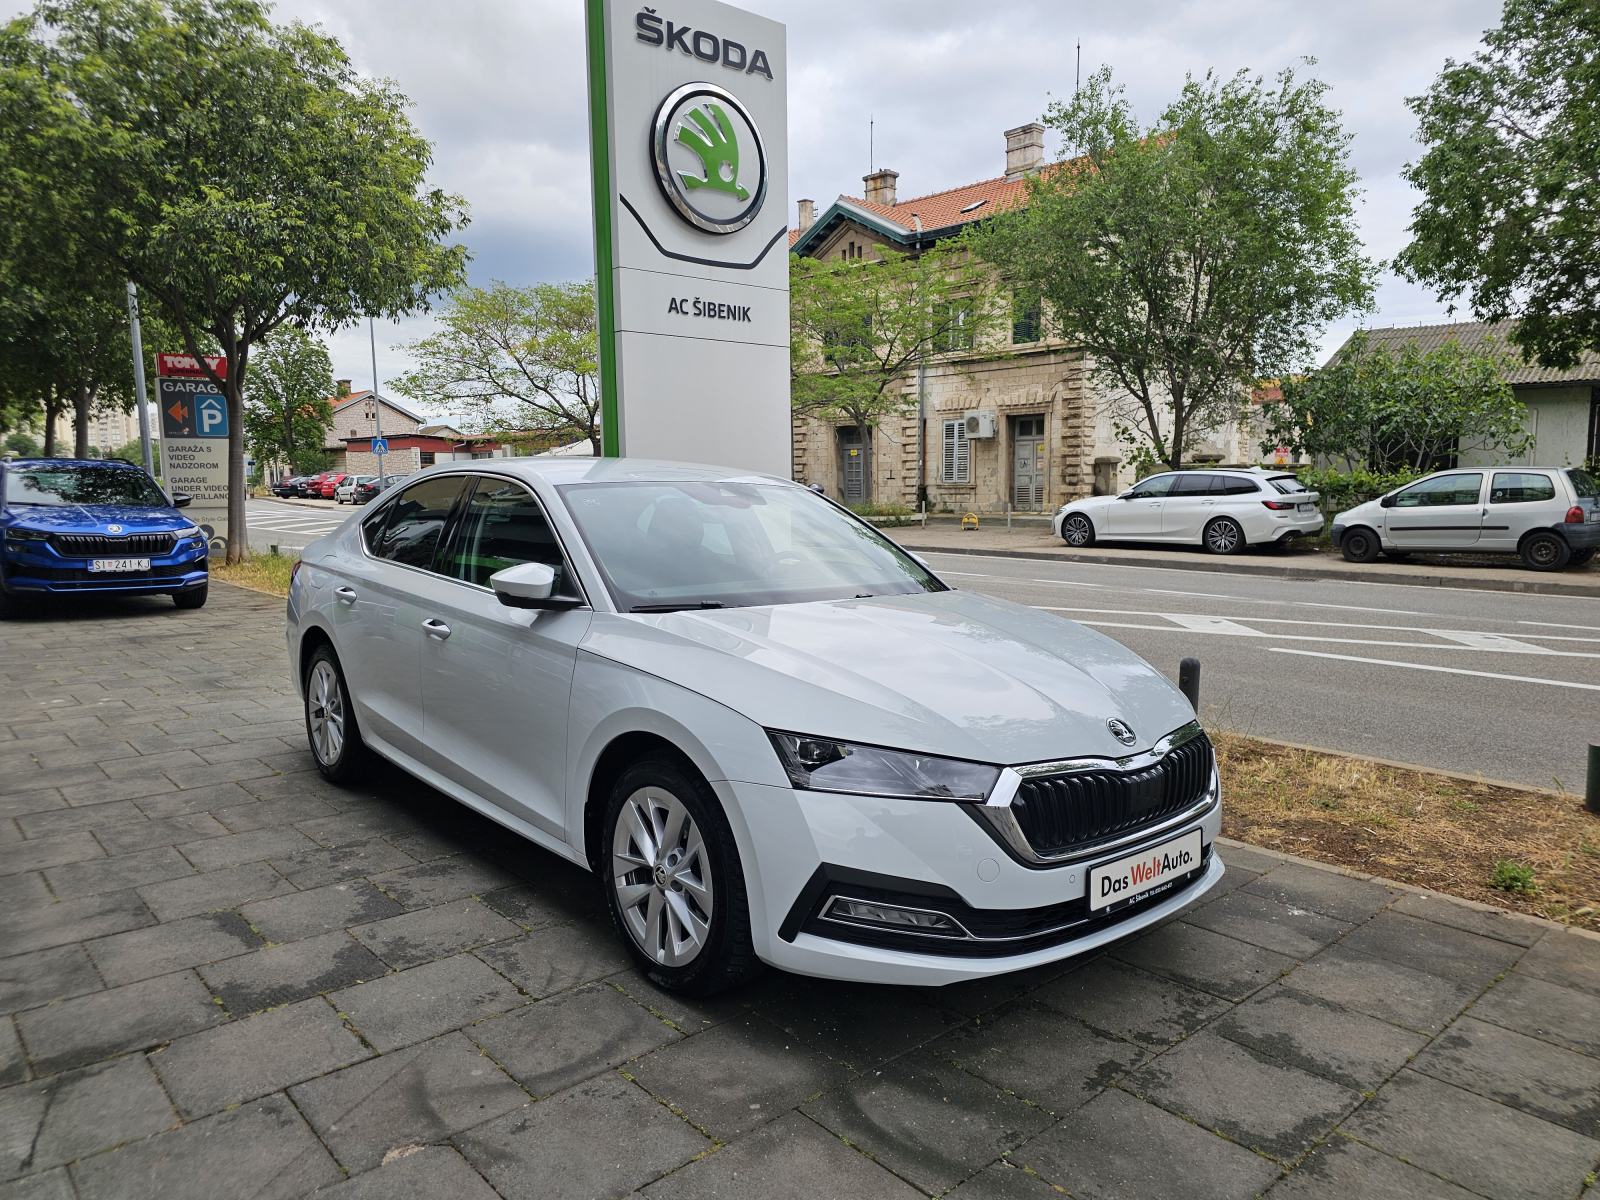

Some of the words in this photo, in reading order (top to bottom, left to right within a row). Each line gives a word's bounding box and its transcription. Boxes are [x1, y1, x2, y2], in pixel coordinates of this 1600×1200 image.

[636, 6, 773, 80] ŠKODA
[668, 297, 689, 315] AC
[692, 296, 752, 322] ŠIBENIK
[163, 355, 221, 370] TOMY
[162, 381, 223, 394] GARAG
[202, 409, 222, 433] P
[168, 445, 205, 453] GARAŽA
[169, 462, 219, 470] NADZOROM
[203, 484, 228, 492] VIDEO
[1101, 873, 1129, 898] Das
